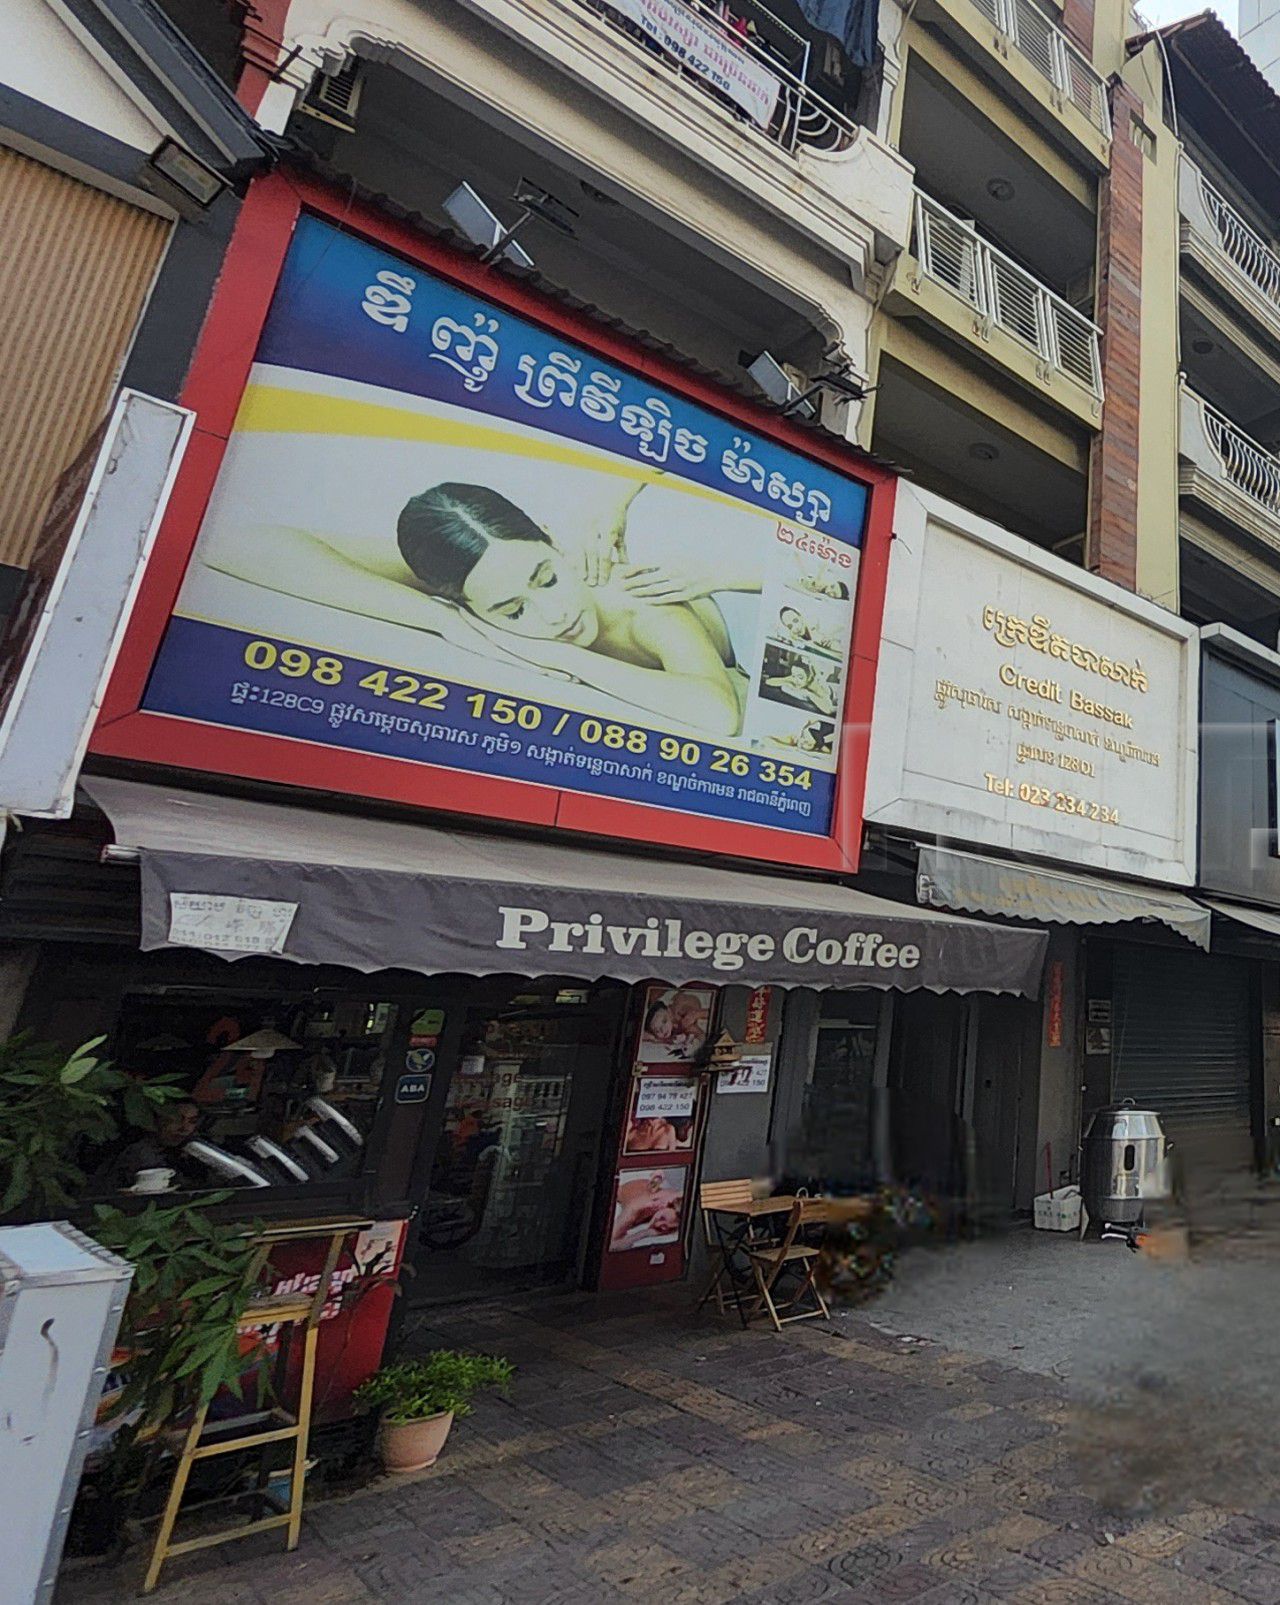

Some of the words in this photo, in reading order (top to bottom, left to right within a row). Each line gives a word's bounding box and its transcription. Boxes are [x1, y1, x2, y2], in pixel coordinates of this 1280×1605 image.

[686, 54, 709, 76] 422
[244, 640, 344, 686] 098
[358, 669, 449, 711] 422
[465, 692, 542, 730] 150
[579, 718, 648, 754] 088
[659, 737, 701, 766] 90
[709, 750, 750, 777] 26
[759, 760, 813, 791] 354
[999, 662, 1063, 705] Credit
[1069, 688, 1134, 730] Bassak
[1019, 782, 1050, 808] 023
[1053, 790, 1087, 816] 234
[1089, 802, 1120, 826] 234
[495, 906, 775, 971] Privilege
[782, 926, 921, 970] Coffee
[400, 1084, 425, 1093] ABA
